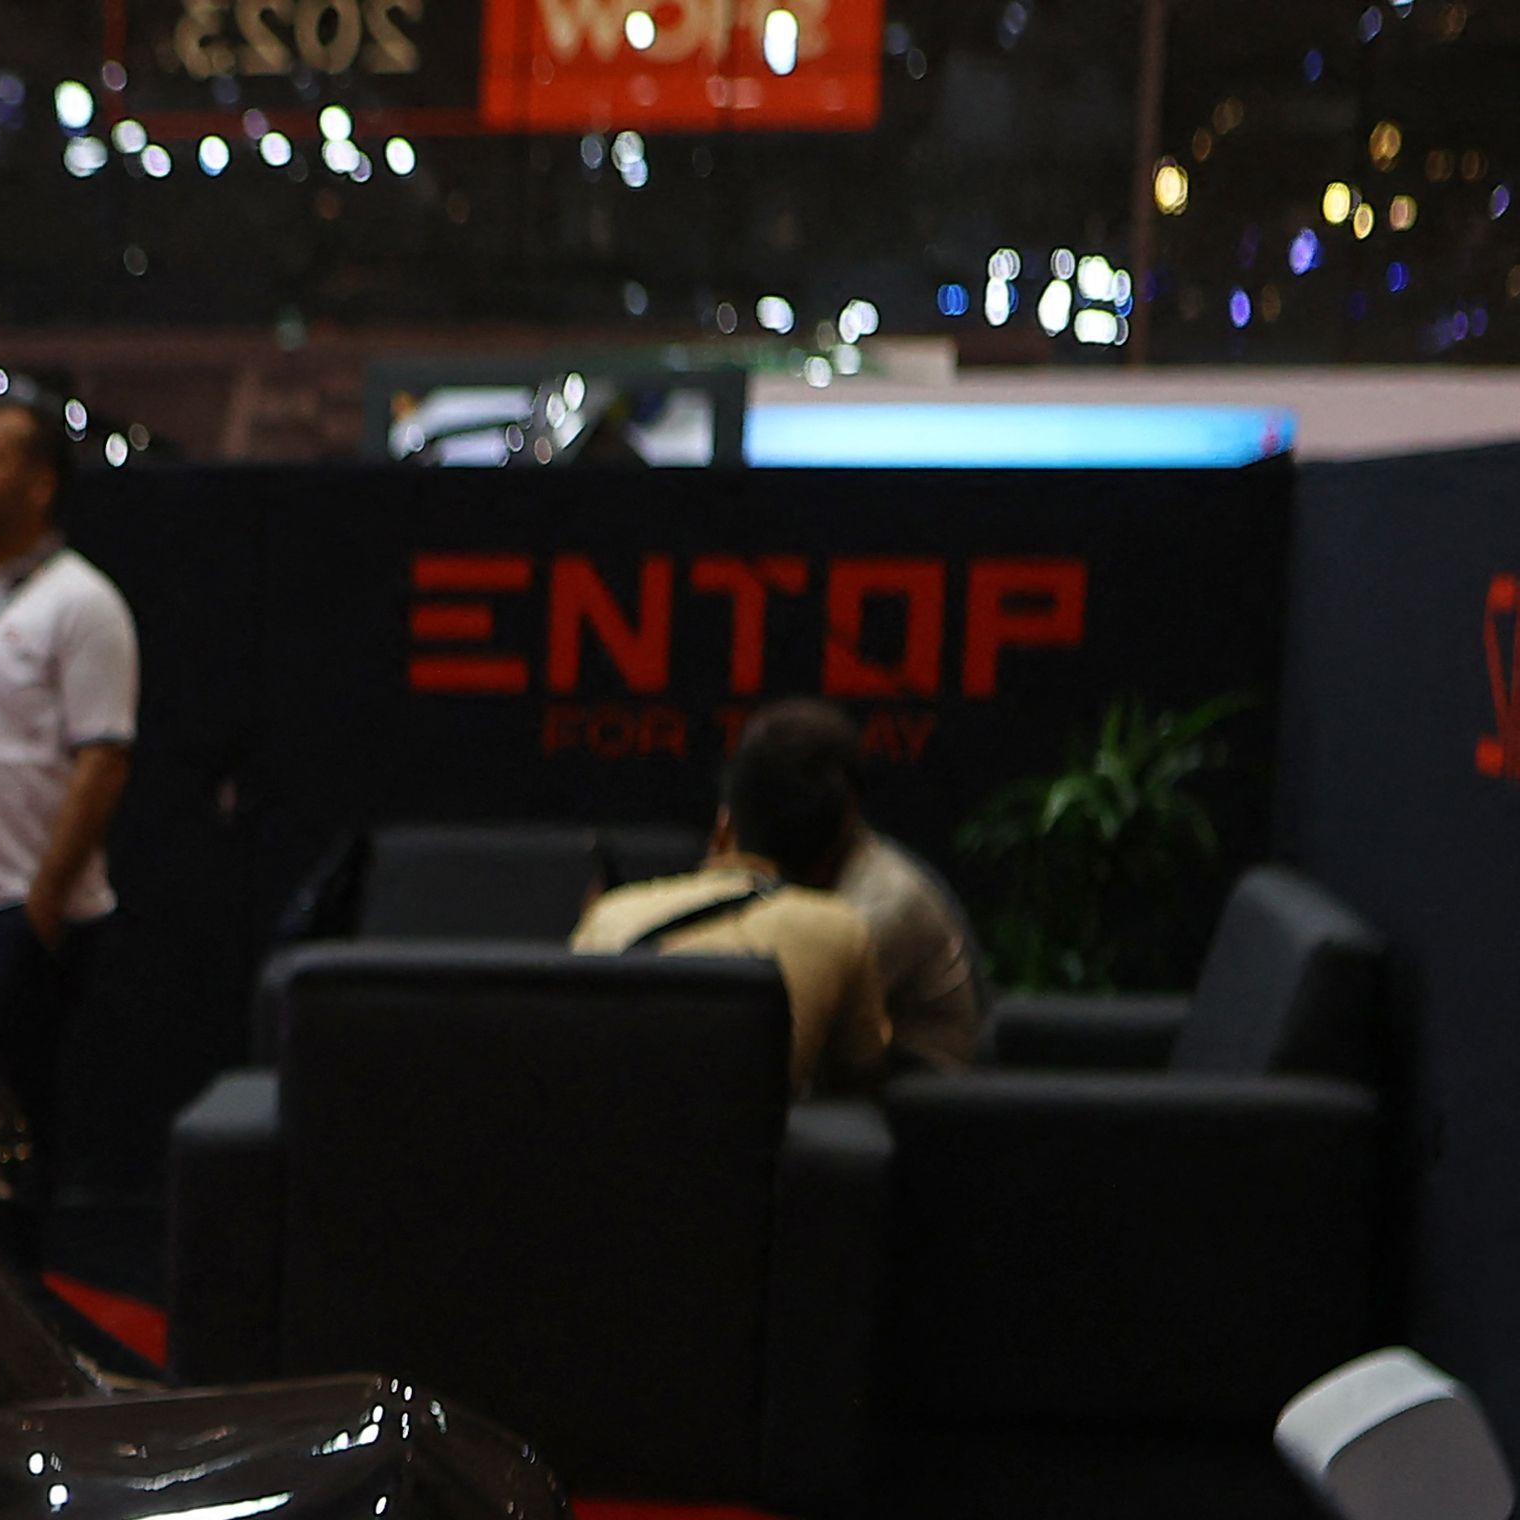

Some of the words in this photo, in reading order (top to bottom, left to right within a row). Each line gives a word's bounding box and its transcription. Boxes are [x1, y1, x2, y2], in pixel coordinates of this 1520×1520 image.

[408, 554, 1088, 698] ENTOP
[543, 703, 688, 760] FOR
[717, 707, 938, 764] TAY
